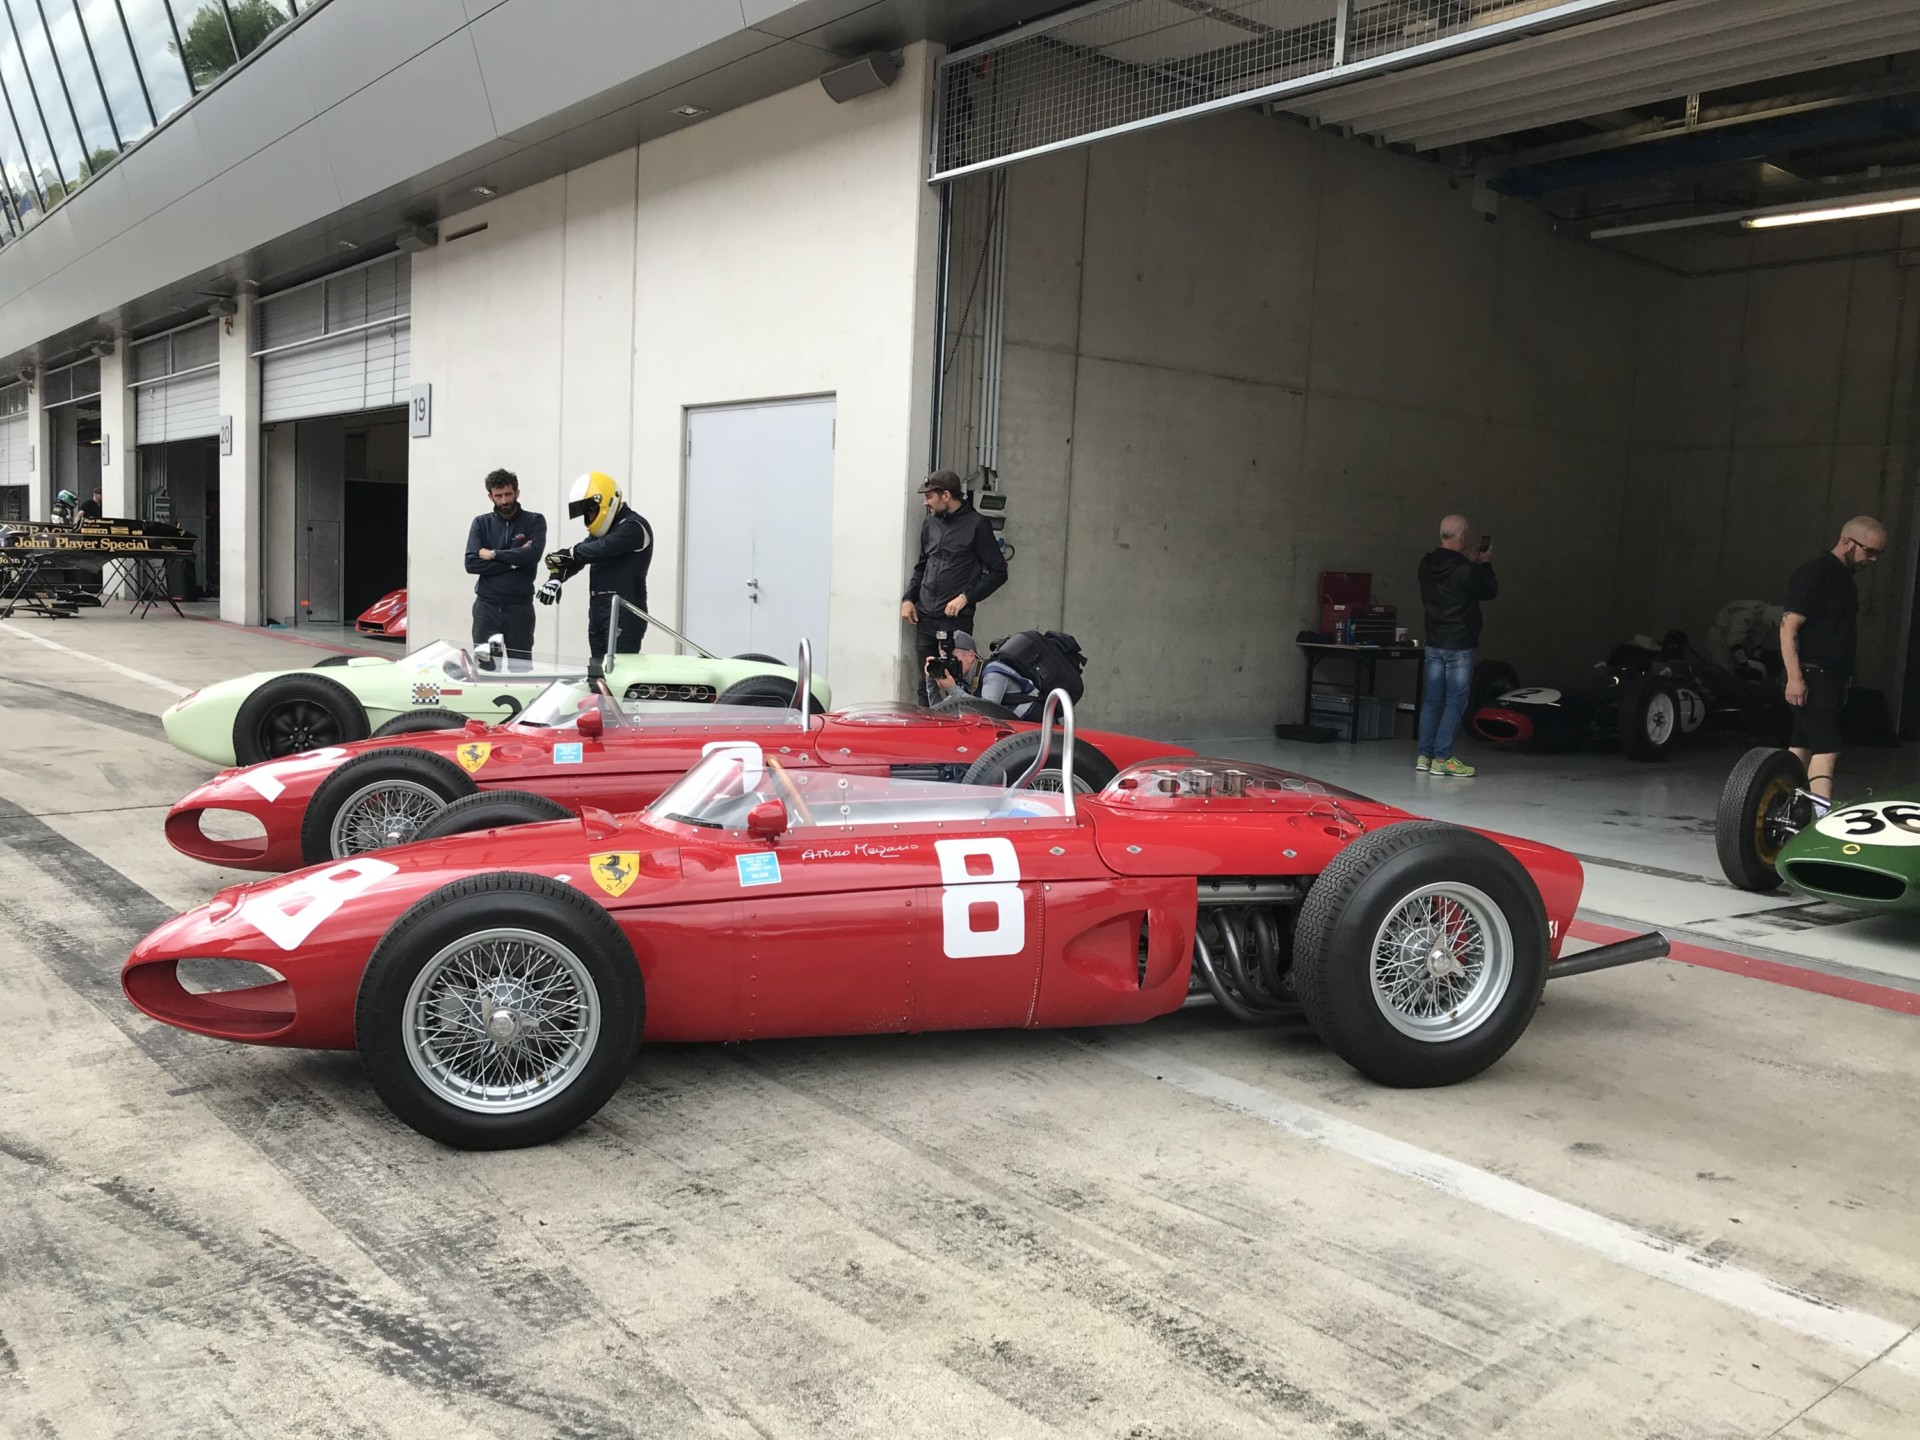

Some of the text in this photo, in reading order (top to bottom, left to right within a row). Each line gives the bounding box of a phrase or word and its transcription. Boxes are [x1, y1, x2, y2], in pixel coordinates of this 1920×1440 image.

[413, 396, 426, 422] 19
[220, 425, 230, 444] 20
[15, 536, 149, 552] John Player Special
[1511, 689, 1543, 699] 2
[1833, 804, 1920, 835] 36
[240, 857, 400, 951] 8
[934, 837, 1025, 960] 8
